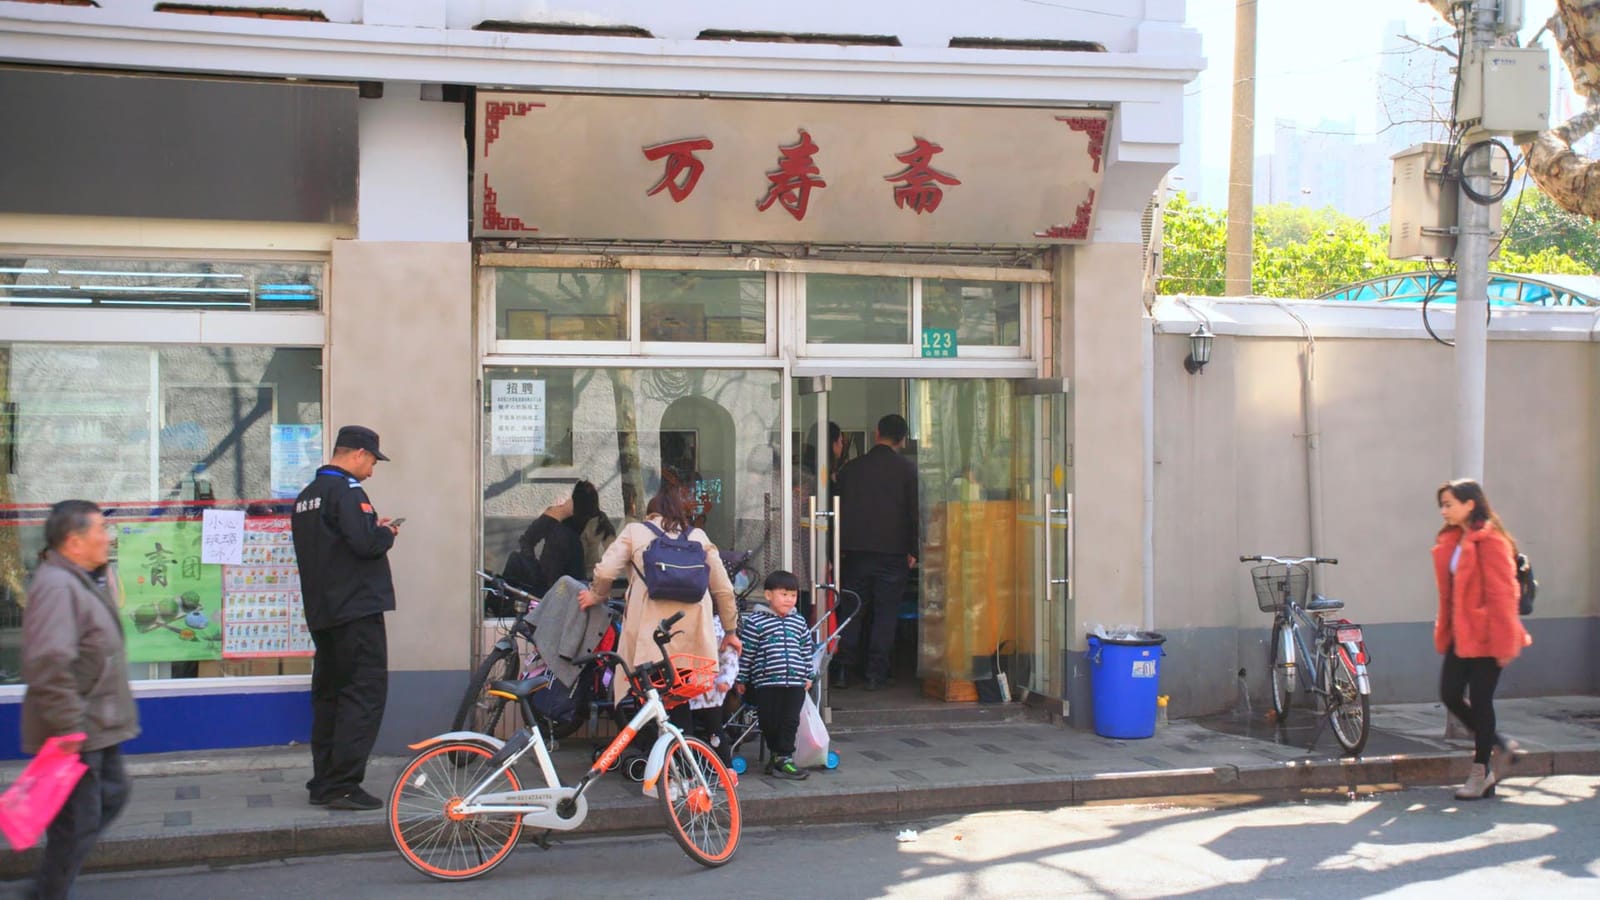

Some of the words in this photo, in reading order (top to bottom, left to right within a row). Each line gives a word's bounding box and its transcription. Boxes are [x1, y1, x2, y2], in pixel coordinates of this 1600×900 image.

[642, 128, 962, 221] 万寿斋
[922, 332, 952, 348] 123
[506, 383, 534, 395] 招聘
[208, 514, 238, 530] 小心
[141, 542, 201, 588] 青团
